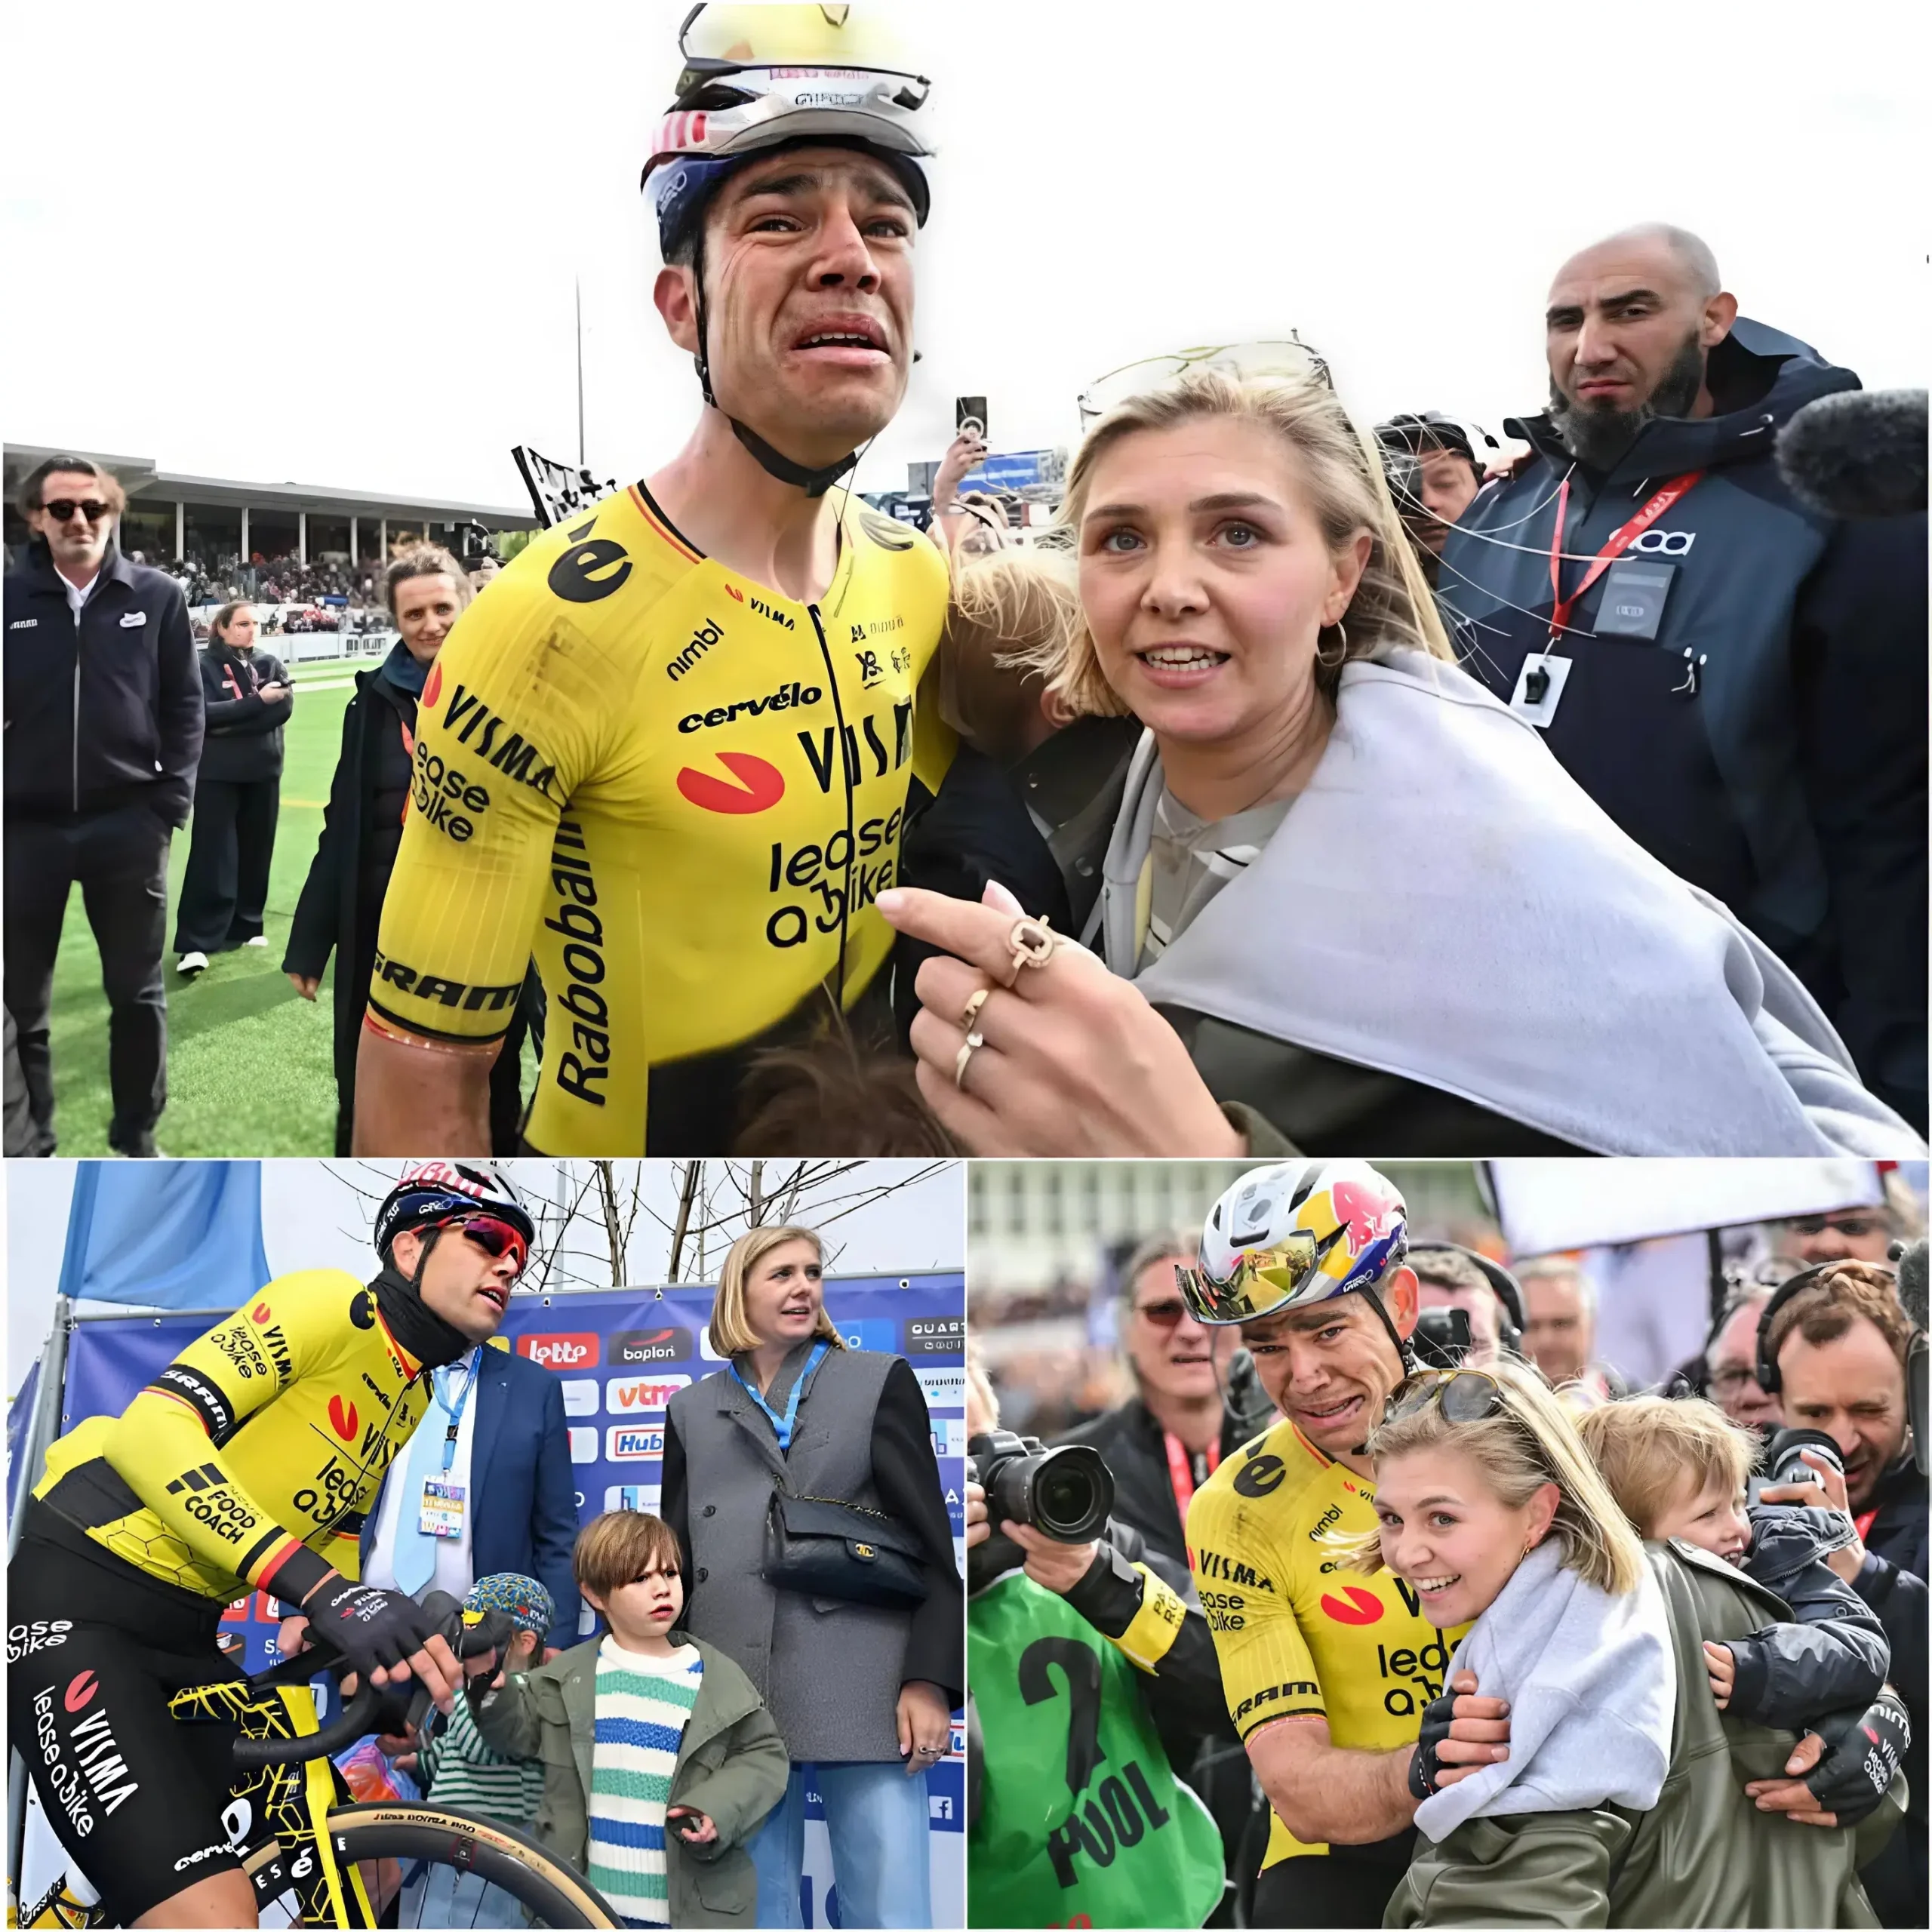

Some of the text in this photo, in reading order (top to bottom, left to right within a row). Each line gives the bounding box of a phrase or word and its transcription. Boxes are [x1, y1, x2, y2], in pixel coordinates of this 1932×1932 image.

[666, 618, 724, 681] nimbl
[443, 685, 555, 794] VISMA
[770, 807, 902, 893] lease
[766, 860, 893, 948] a bike
[185, 1496, 245, 1545] COACH
[210, 1490, 256, 1528] FOOD
[1309, 1503, 1343, 1542] nimbl
[1200, 1549, 1275, 1594] VISMA
[33, 1685, 94, 1838] lease a bike
[1019, 1636, 1107, 1800] 2
[69, 1709, 139, 1817] VISMA
[1046, 1760, 1171, 1889] POOL
